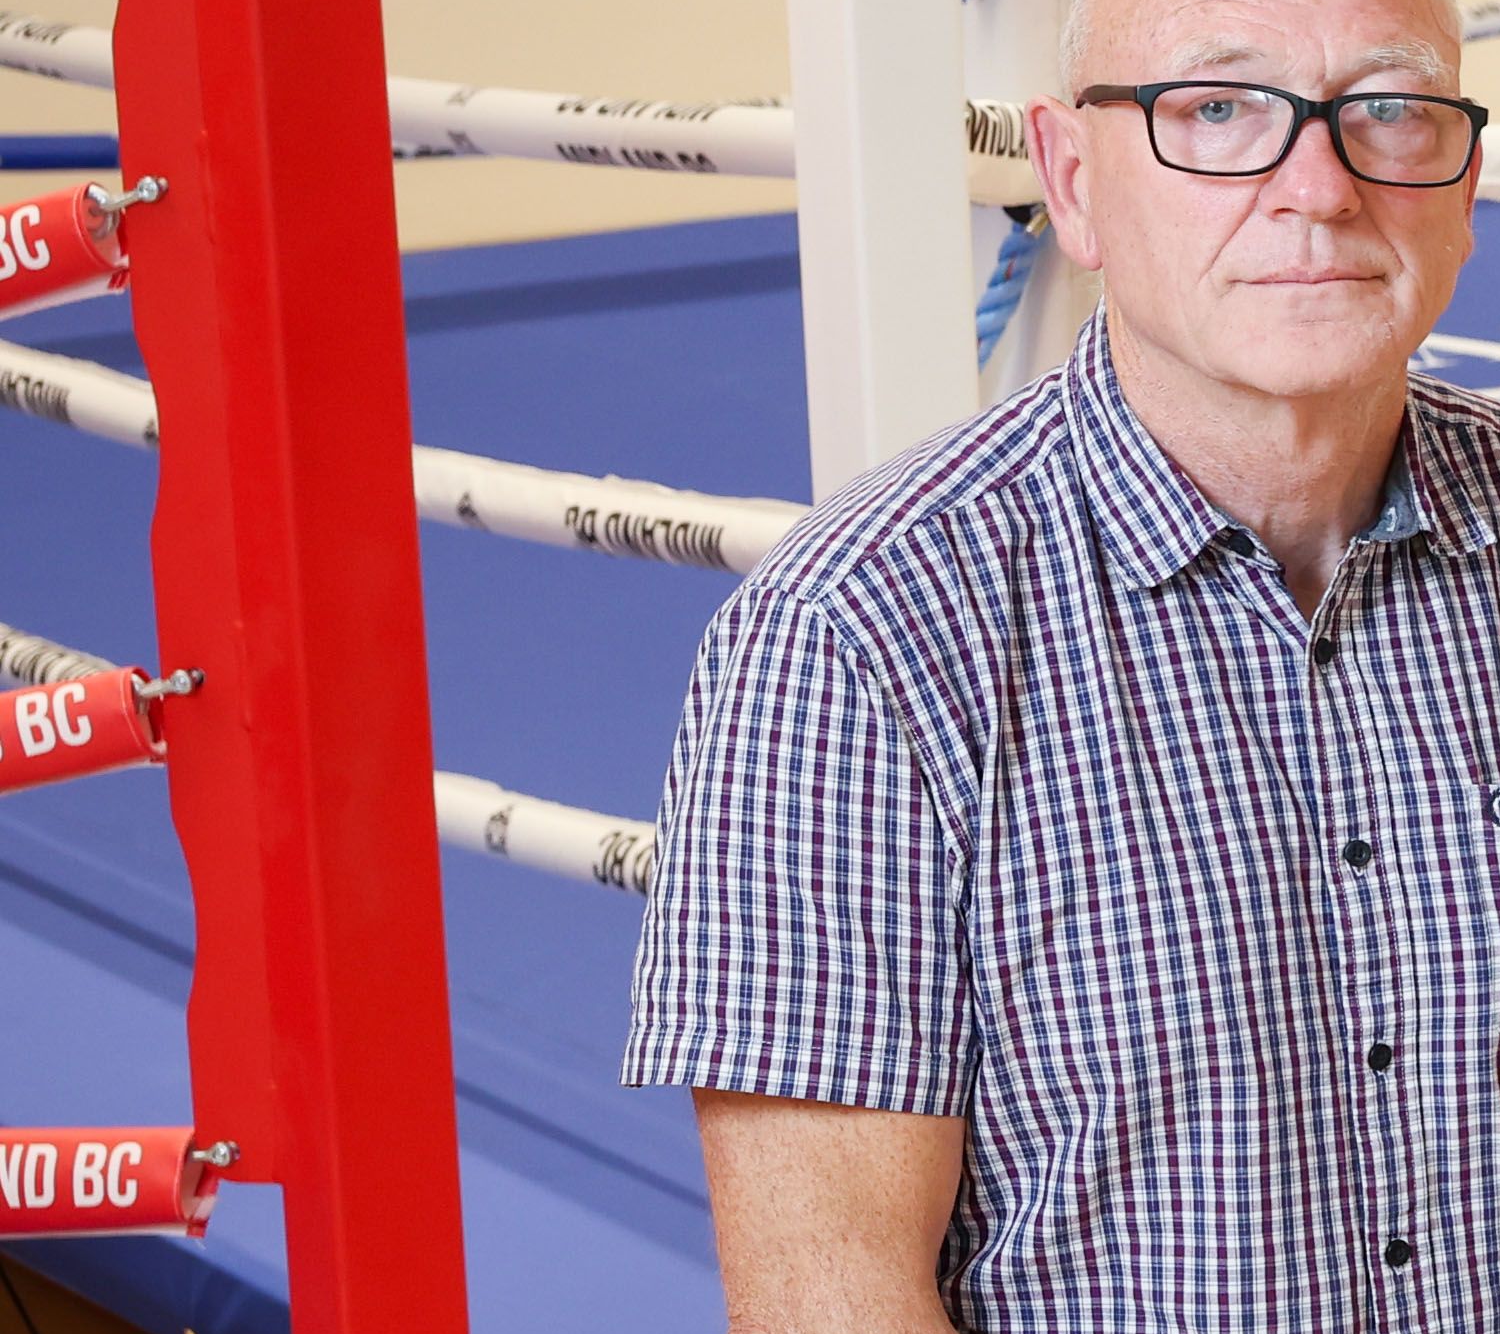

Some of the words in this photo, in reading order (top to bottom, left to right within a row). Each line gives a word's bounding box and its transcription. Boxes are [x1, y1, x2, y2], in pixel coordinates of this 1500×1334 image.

[604, 511, 727, 568] MIDLAND
[15, 682, 92, 758] BC
[72, 1141, 142, 1208] BC
